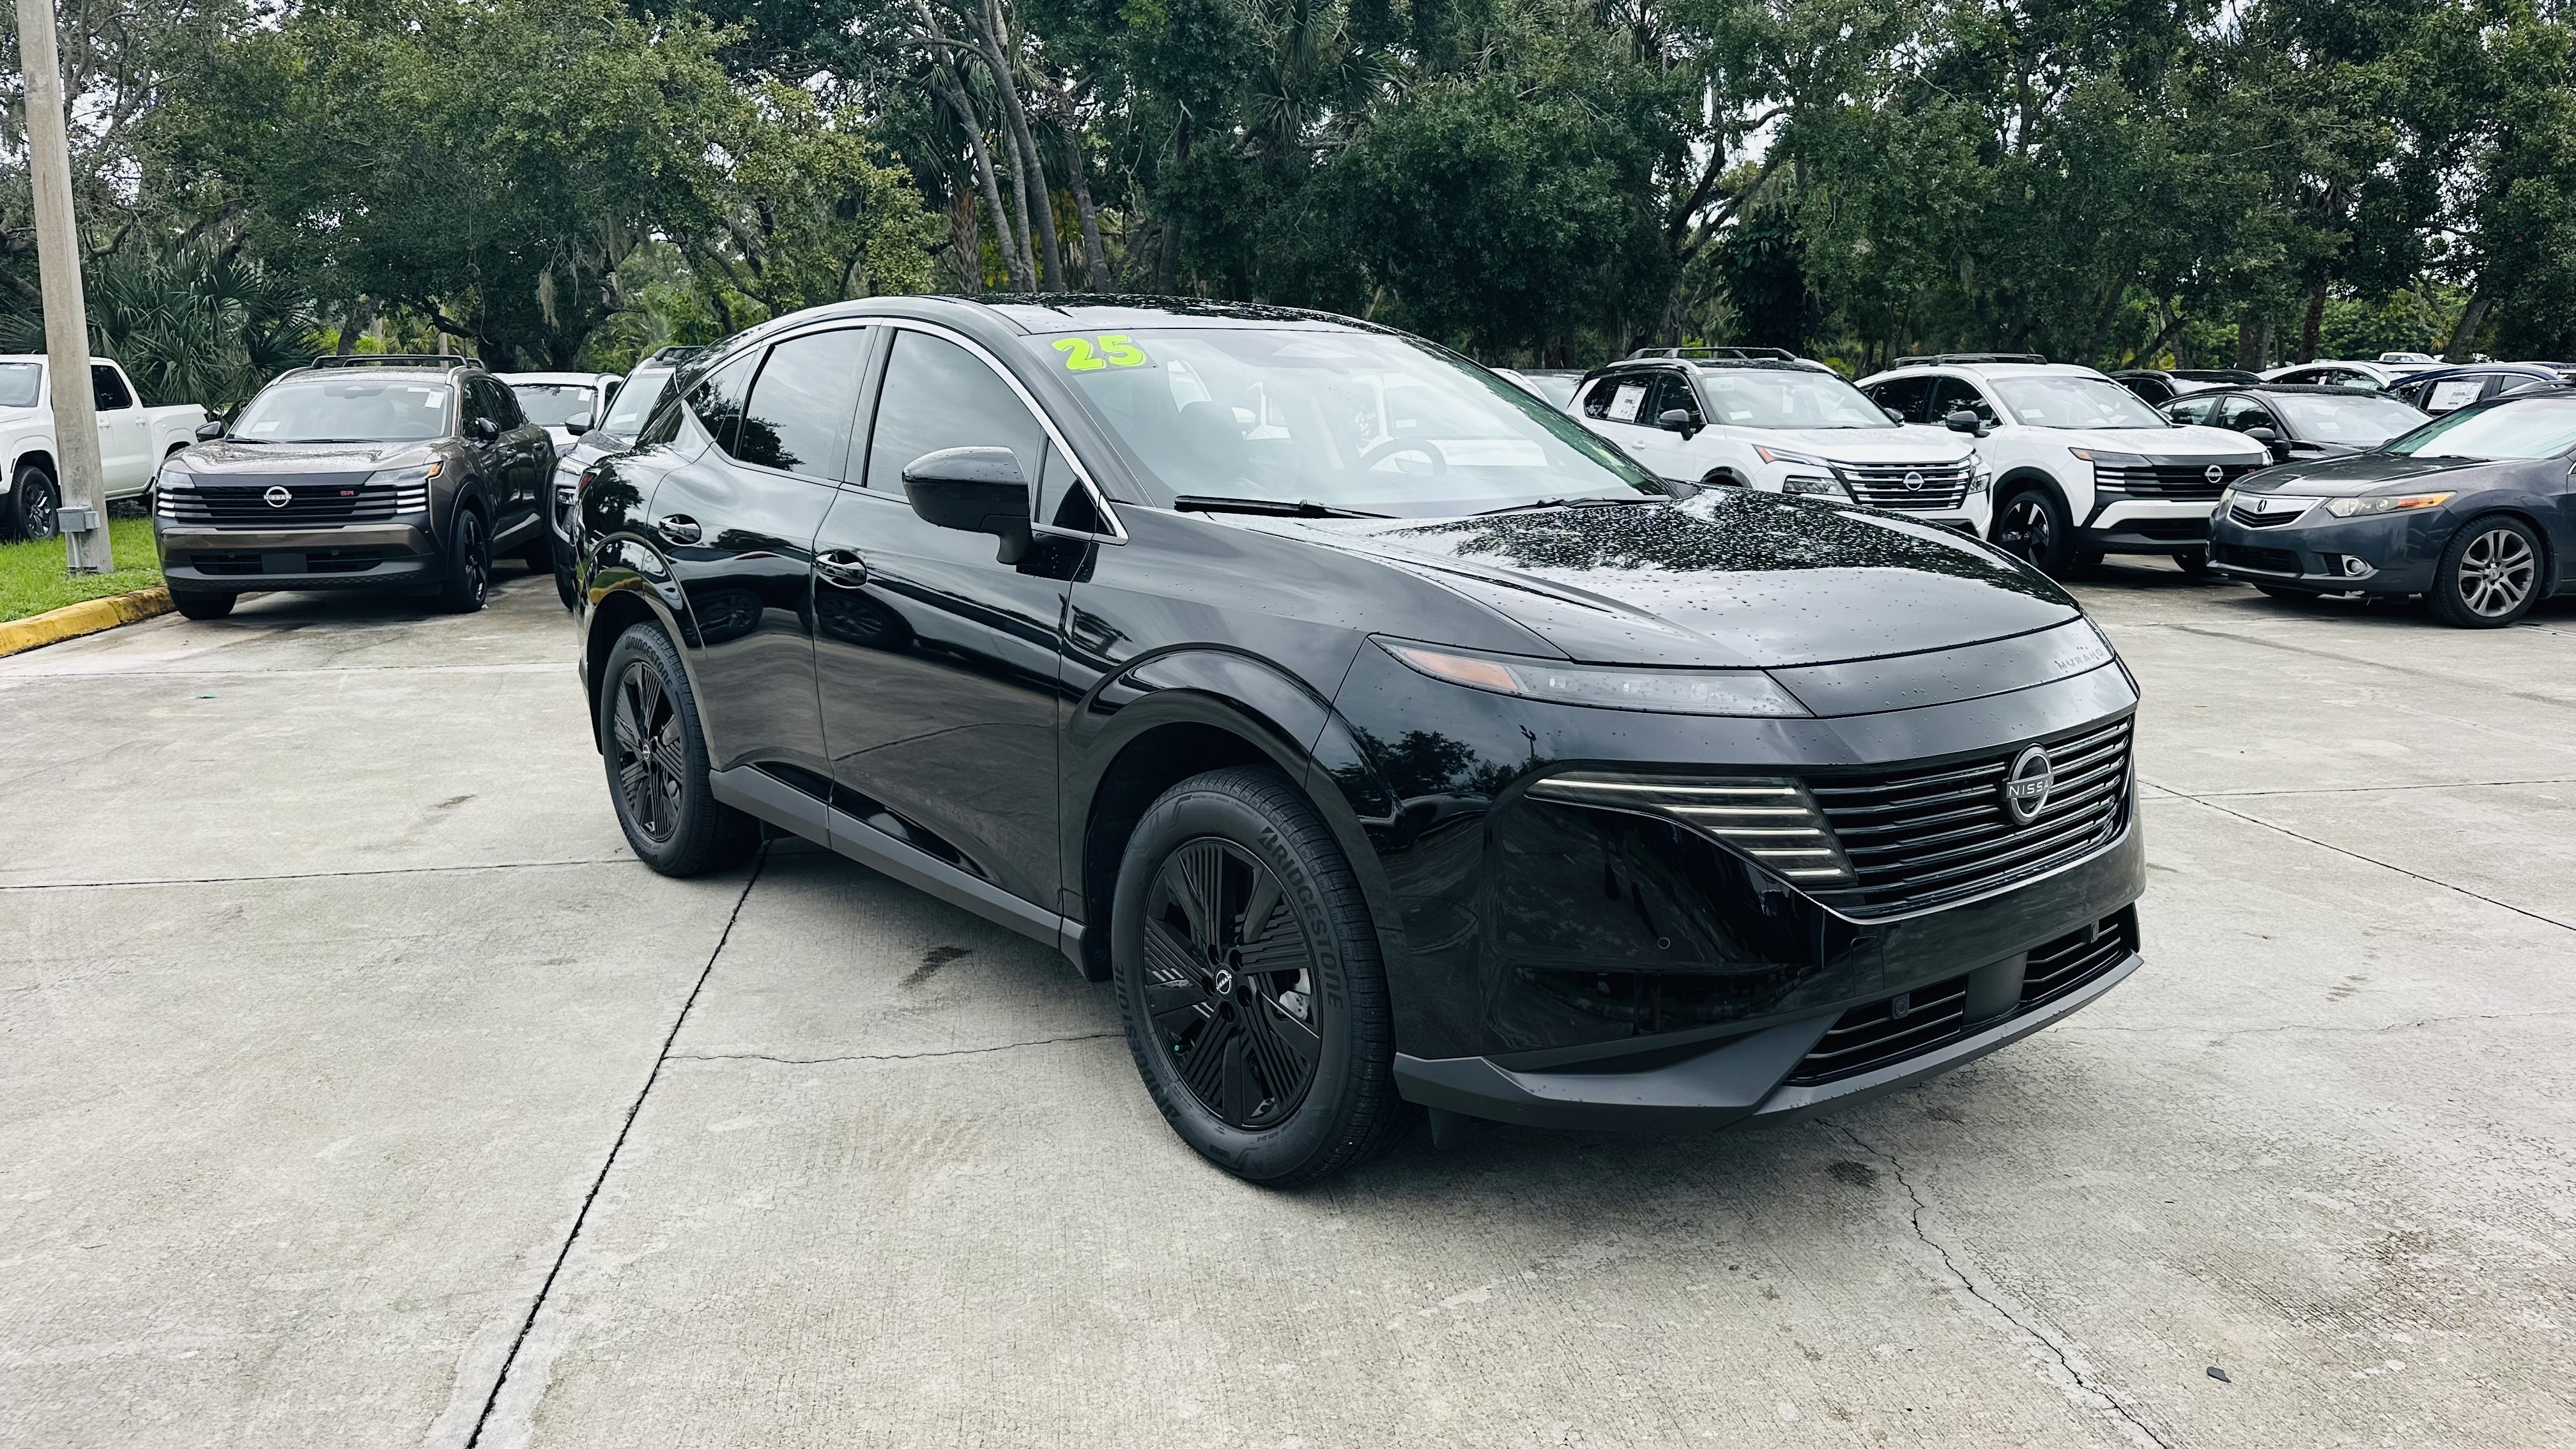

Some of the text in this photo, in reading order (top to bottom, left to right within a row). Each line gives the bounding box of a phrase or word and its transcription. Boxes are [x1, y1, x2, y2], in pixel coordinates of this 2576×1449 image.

[1052, 335, 1147, 371] 25
[625, 636, 673, 689] BRIDGESTONE
[2009, 778, 2053, 796] NISSAN
[1257, 826, 1344, 1009] BRIDGESTONE
